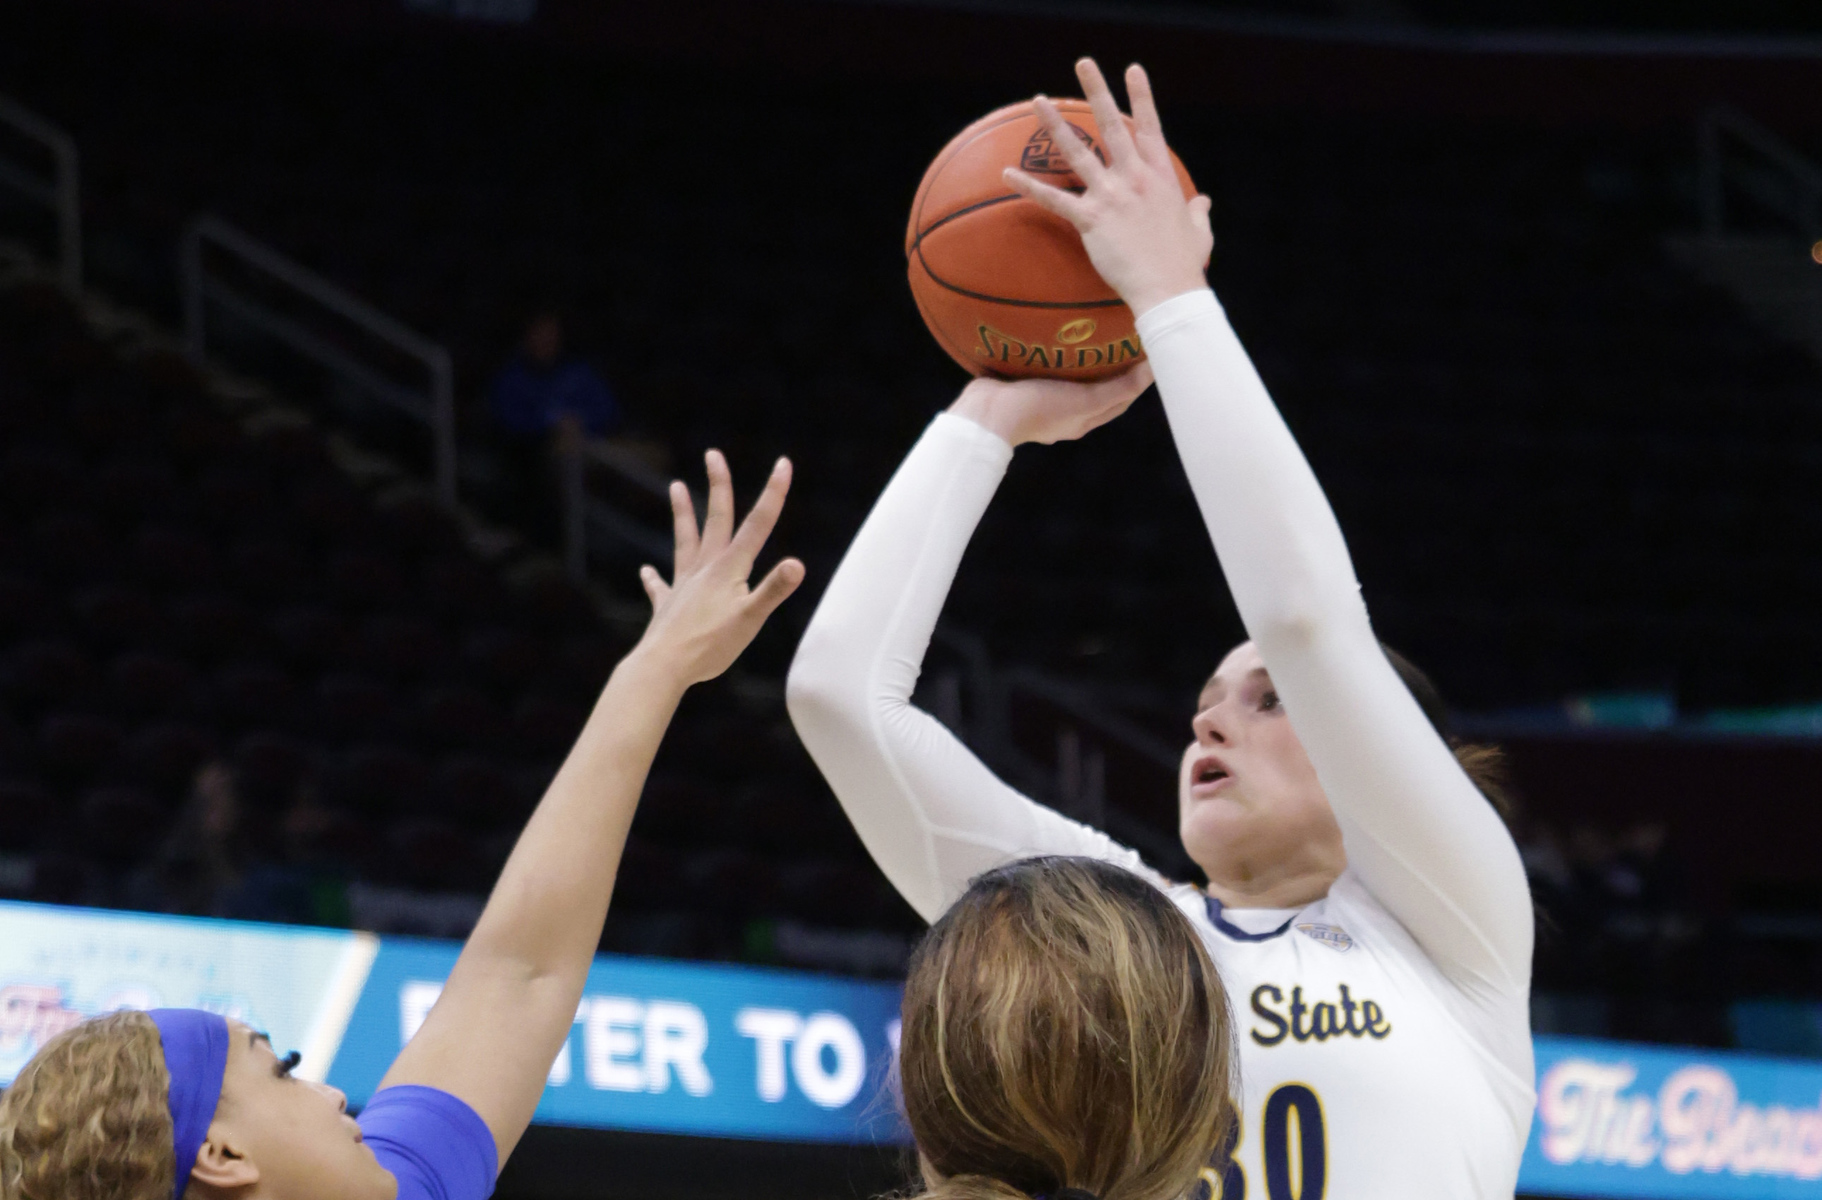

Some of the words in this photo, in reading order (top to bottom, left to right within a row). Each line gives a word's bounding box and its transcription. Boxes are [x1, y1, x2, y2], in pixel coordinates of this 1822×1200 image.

[974, 322, 1146, 370] SPALDIN
[1250, 982, 1391, 1048] State
[735, 1006, 866, 1108] TO
